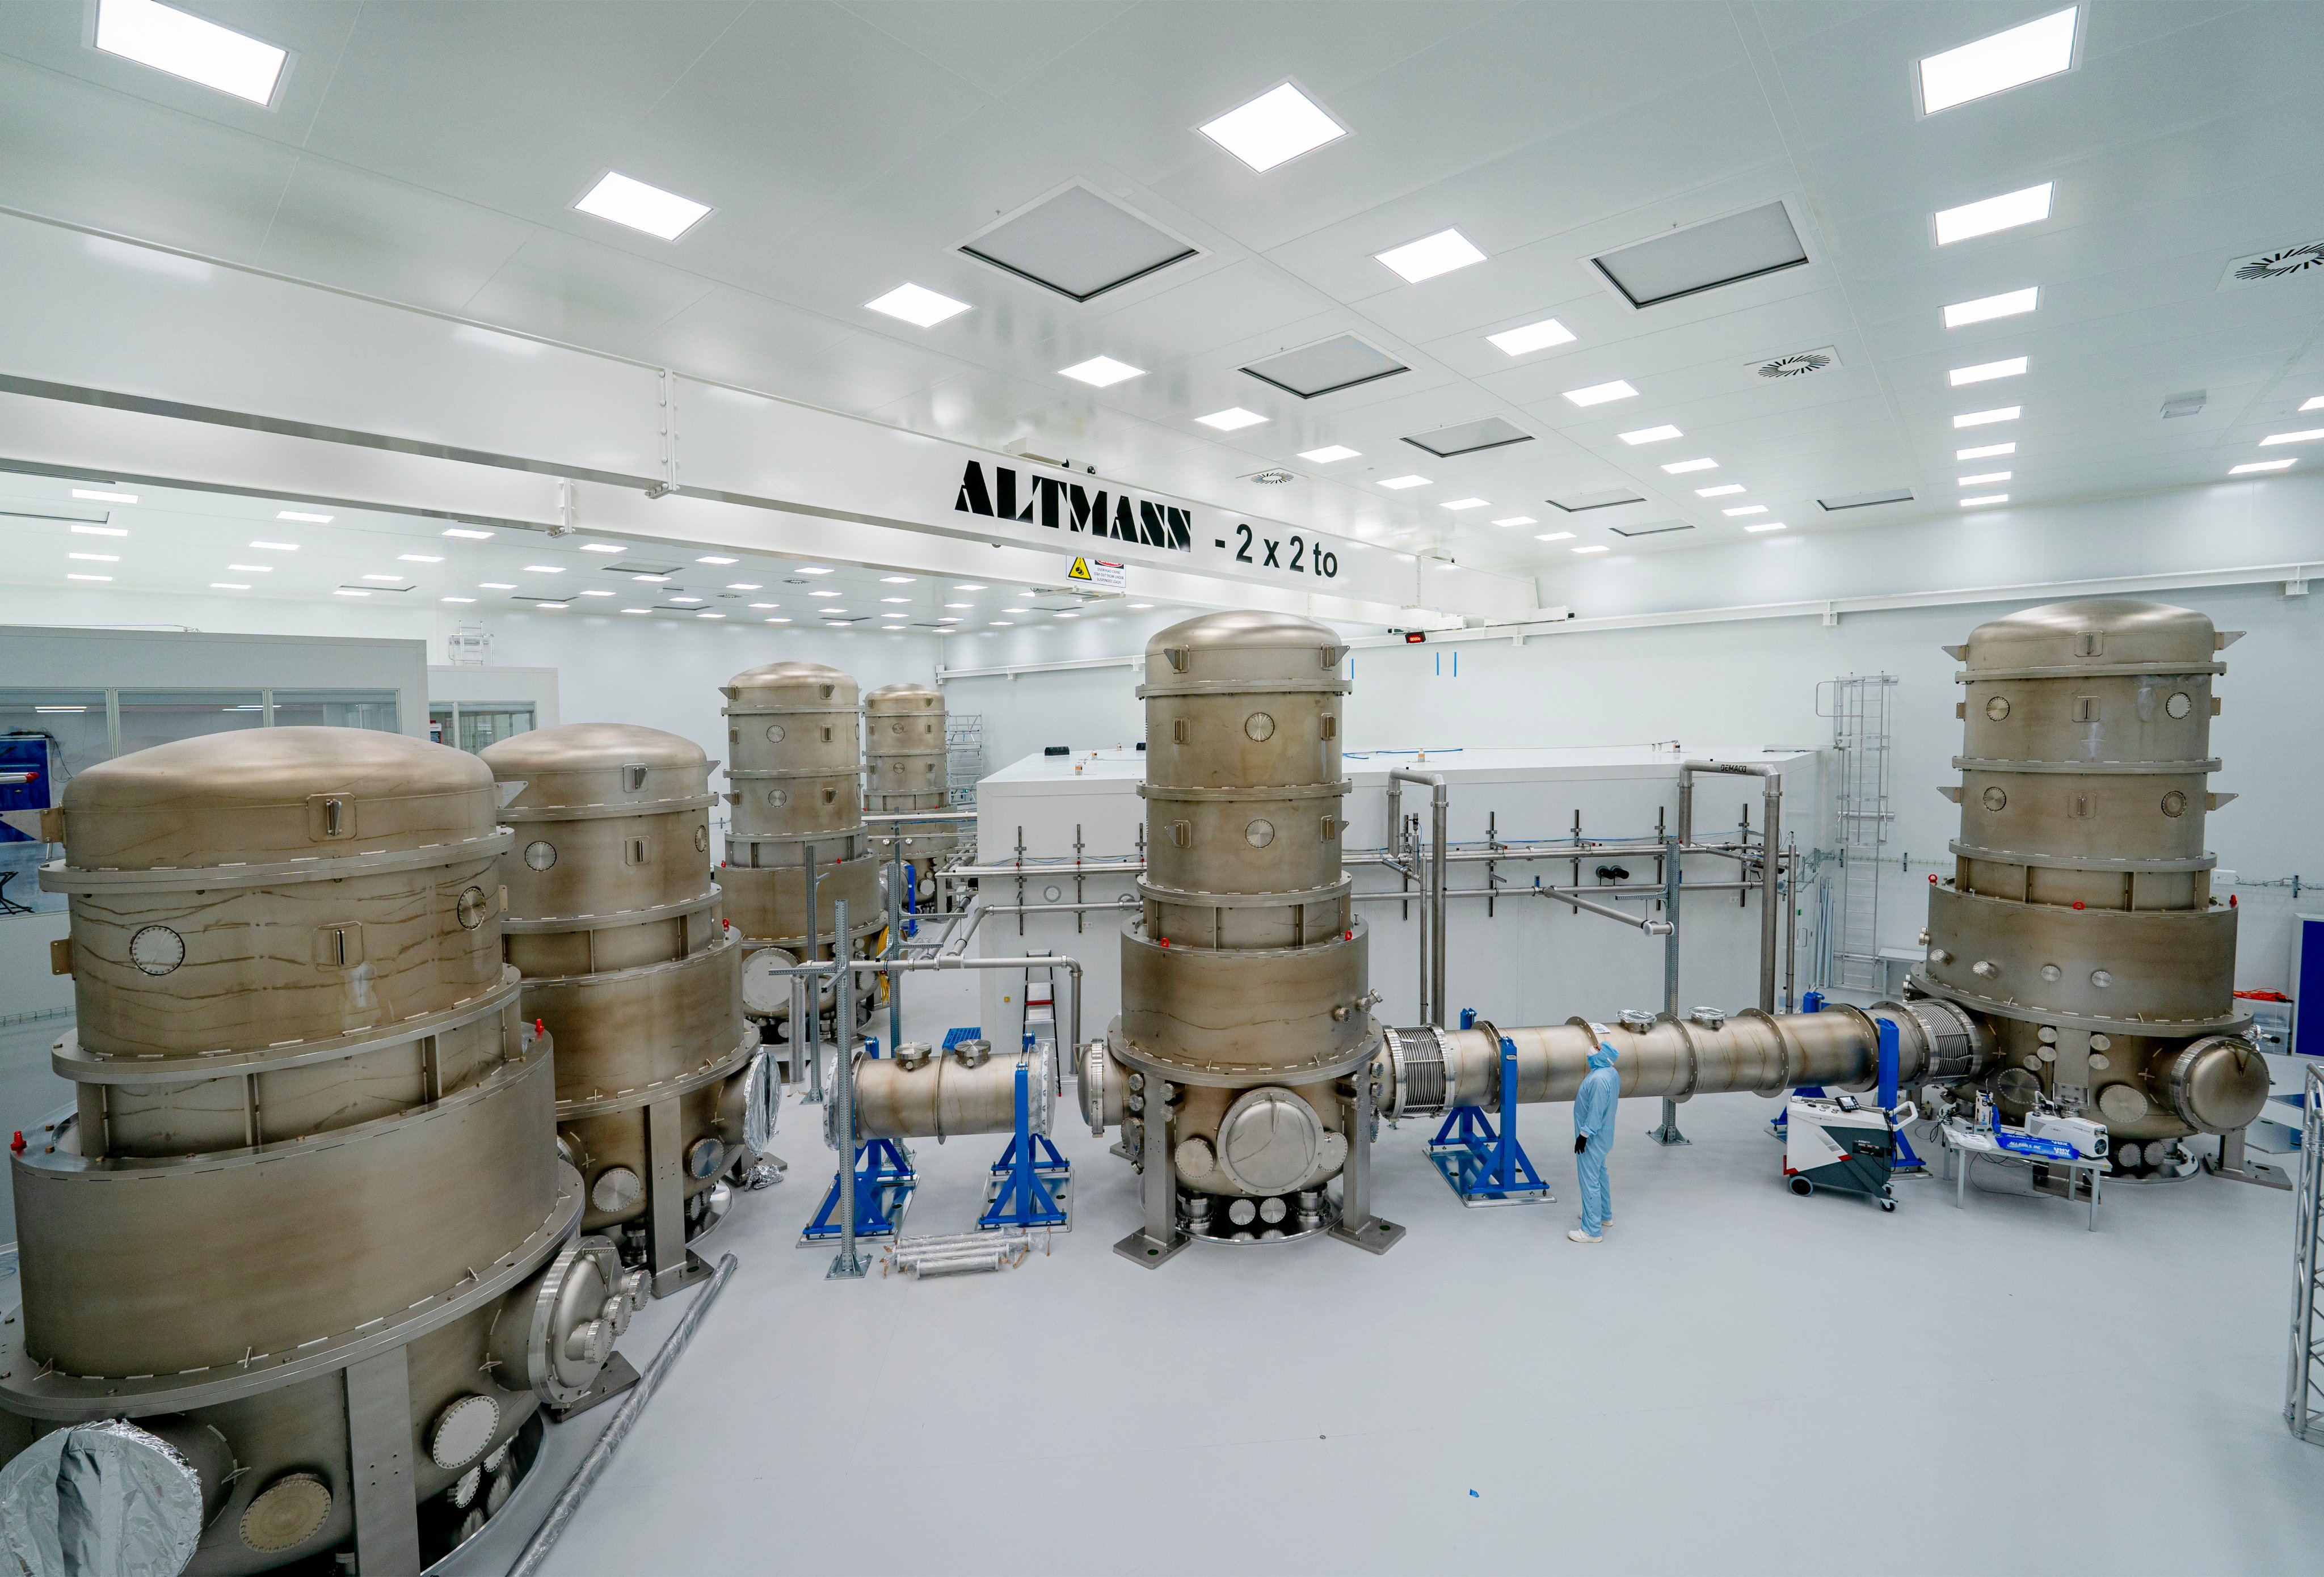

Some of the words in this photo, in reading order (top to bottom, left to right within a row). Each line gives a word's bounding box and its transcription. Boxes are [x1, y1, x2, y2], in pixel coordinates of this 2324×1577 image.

[955, 459, 1190, 553] ALTMANN
[1236, 524, 1252, 564] 2
[1263, 538, 1280, 568] x
[1289, 535, 1304, 573] 2
[1313, 541, 1338, 578] to
